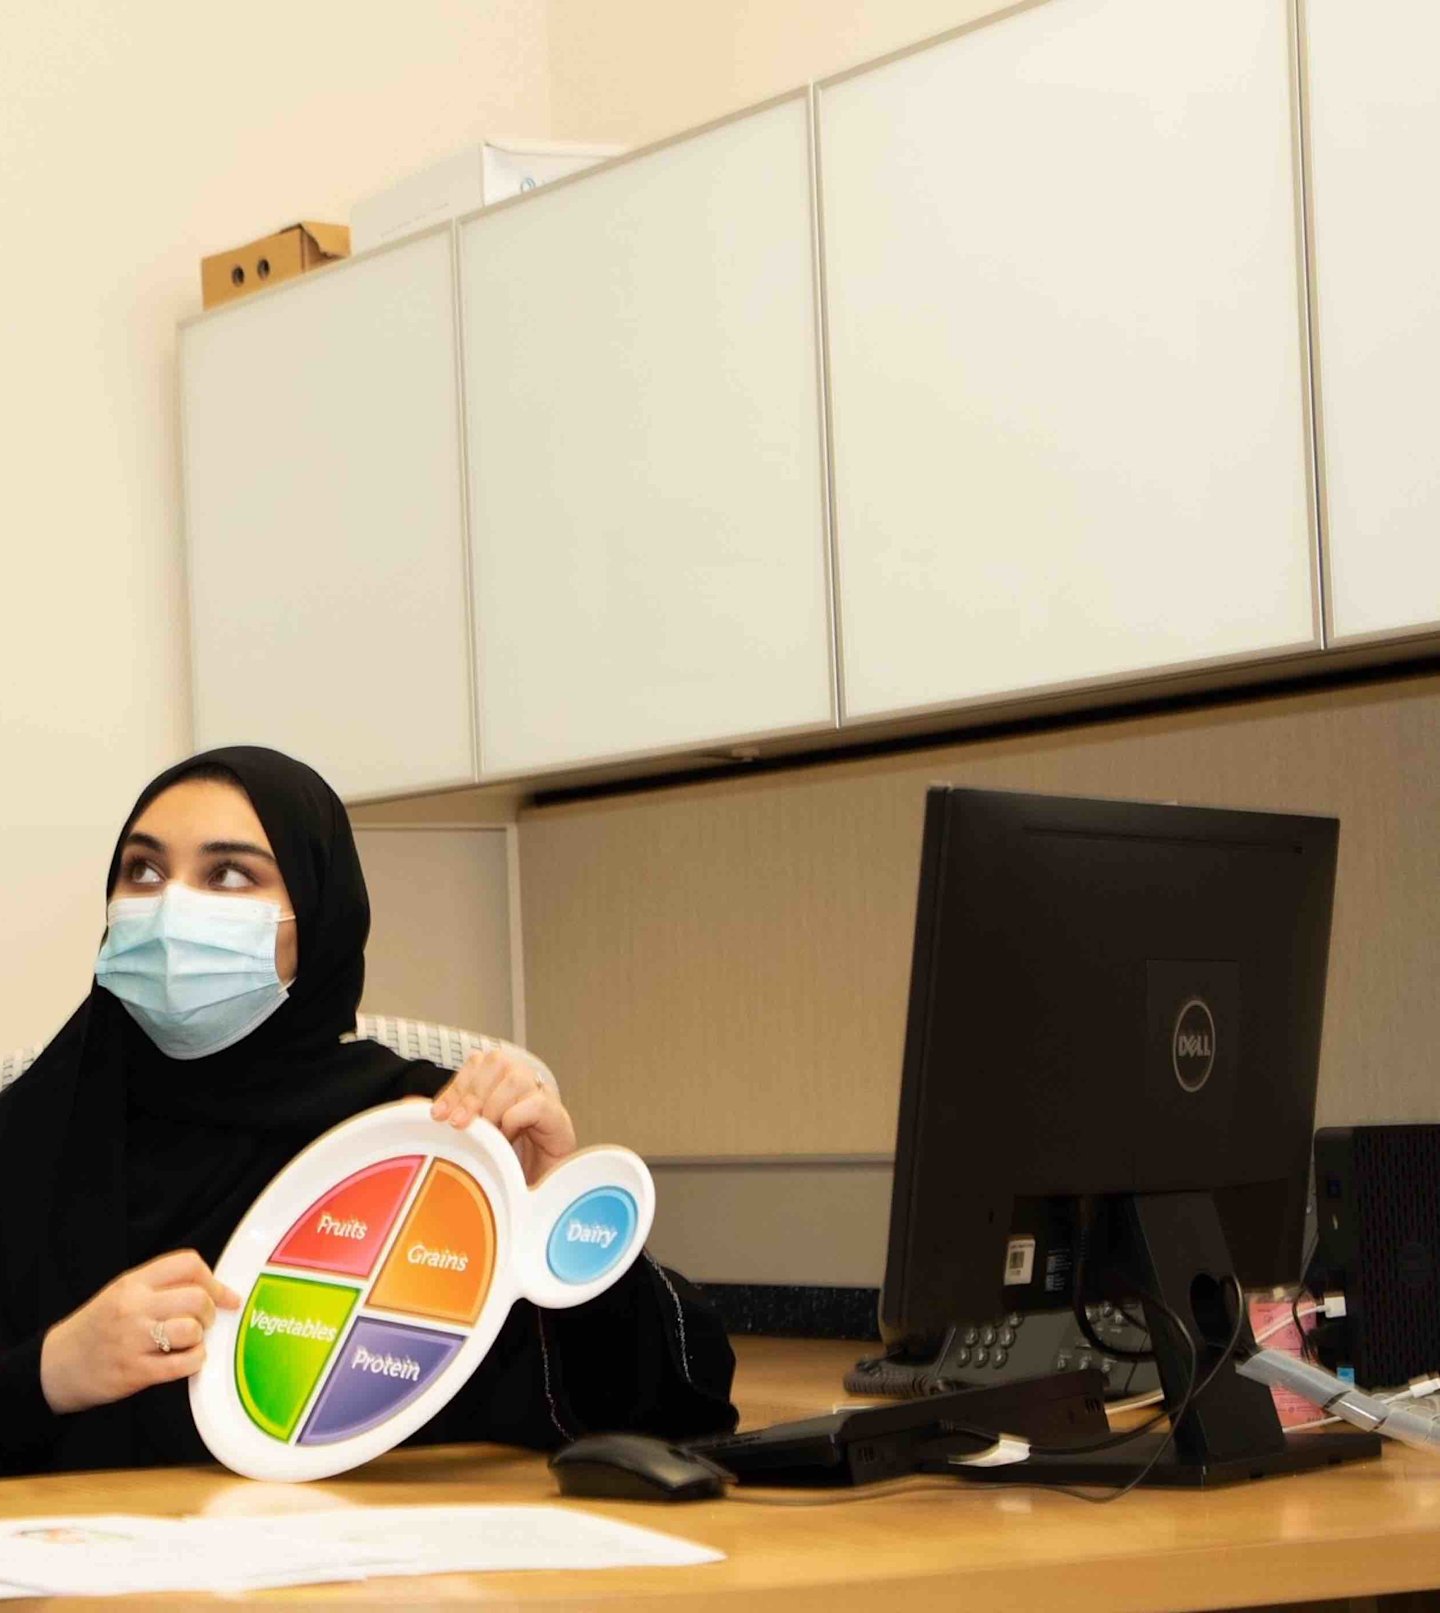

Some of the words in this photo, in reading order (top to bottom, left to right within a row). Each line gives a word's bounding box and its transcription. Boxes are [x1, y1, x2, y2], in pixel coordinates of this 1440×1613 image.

[1178, 1035, 1211, 1058] DELL
[317, 1213, 368, 1240] Fruits
[566, 1220, 618, 1249] Dairy
[407, 1244, 469, 1272] Grains
[249, 1309, 337, 1342] Vegetables
[351, 1348, 420, 1381] Protein
